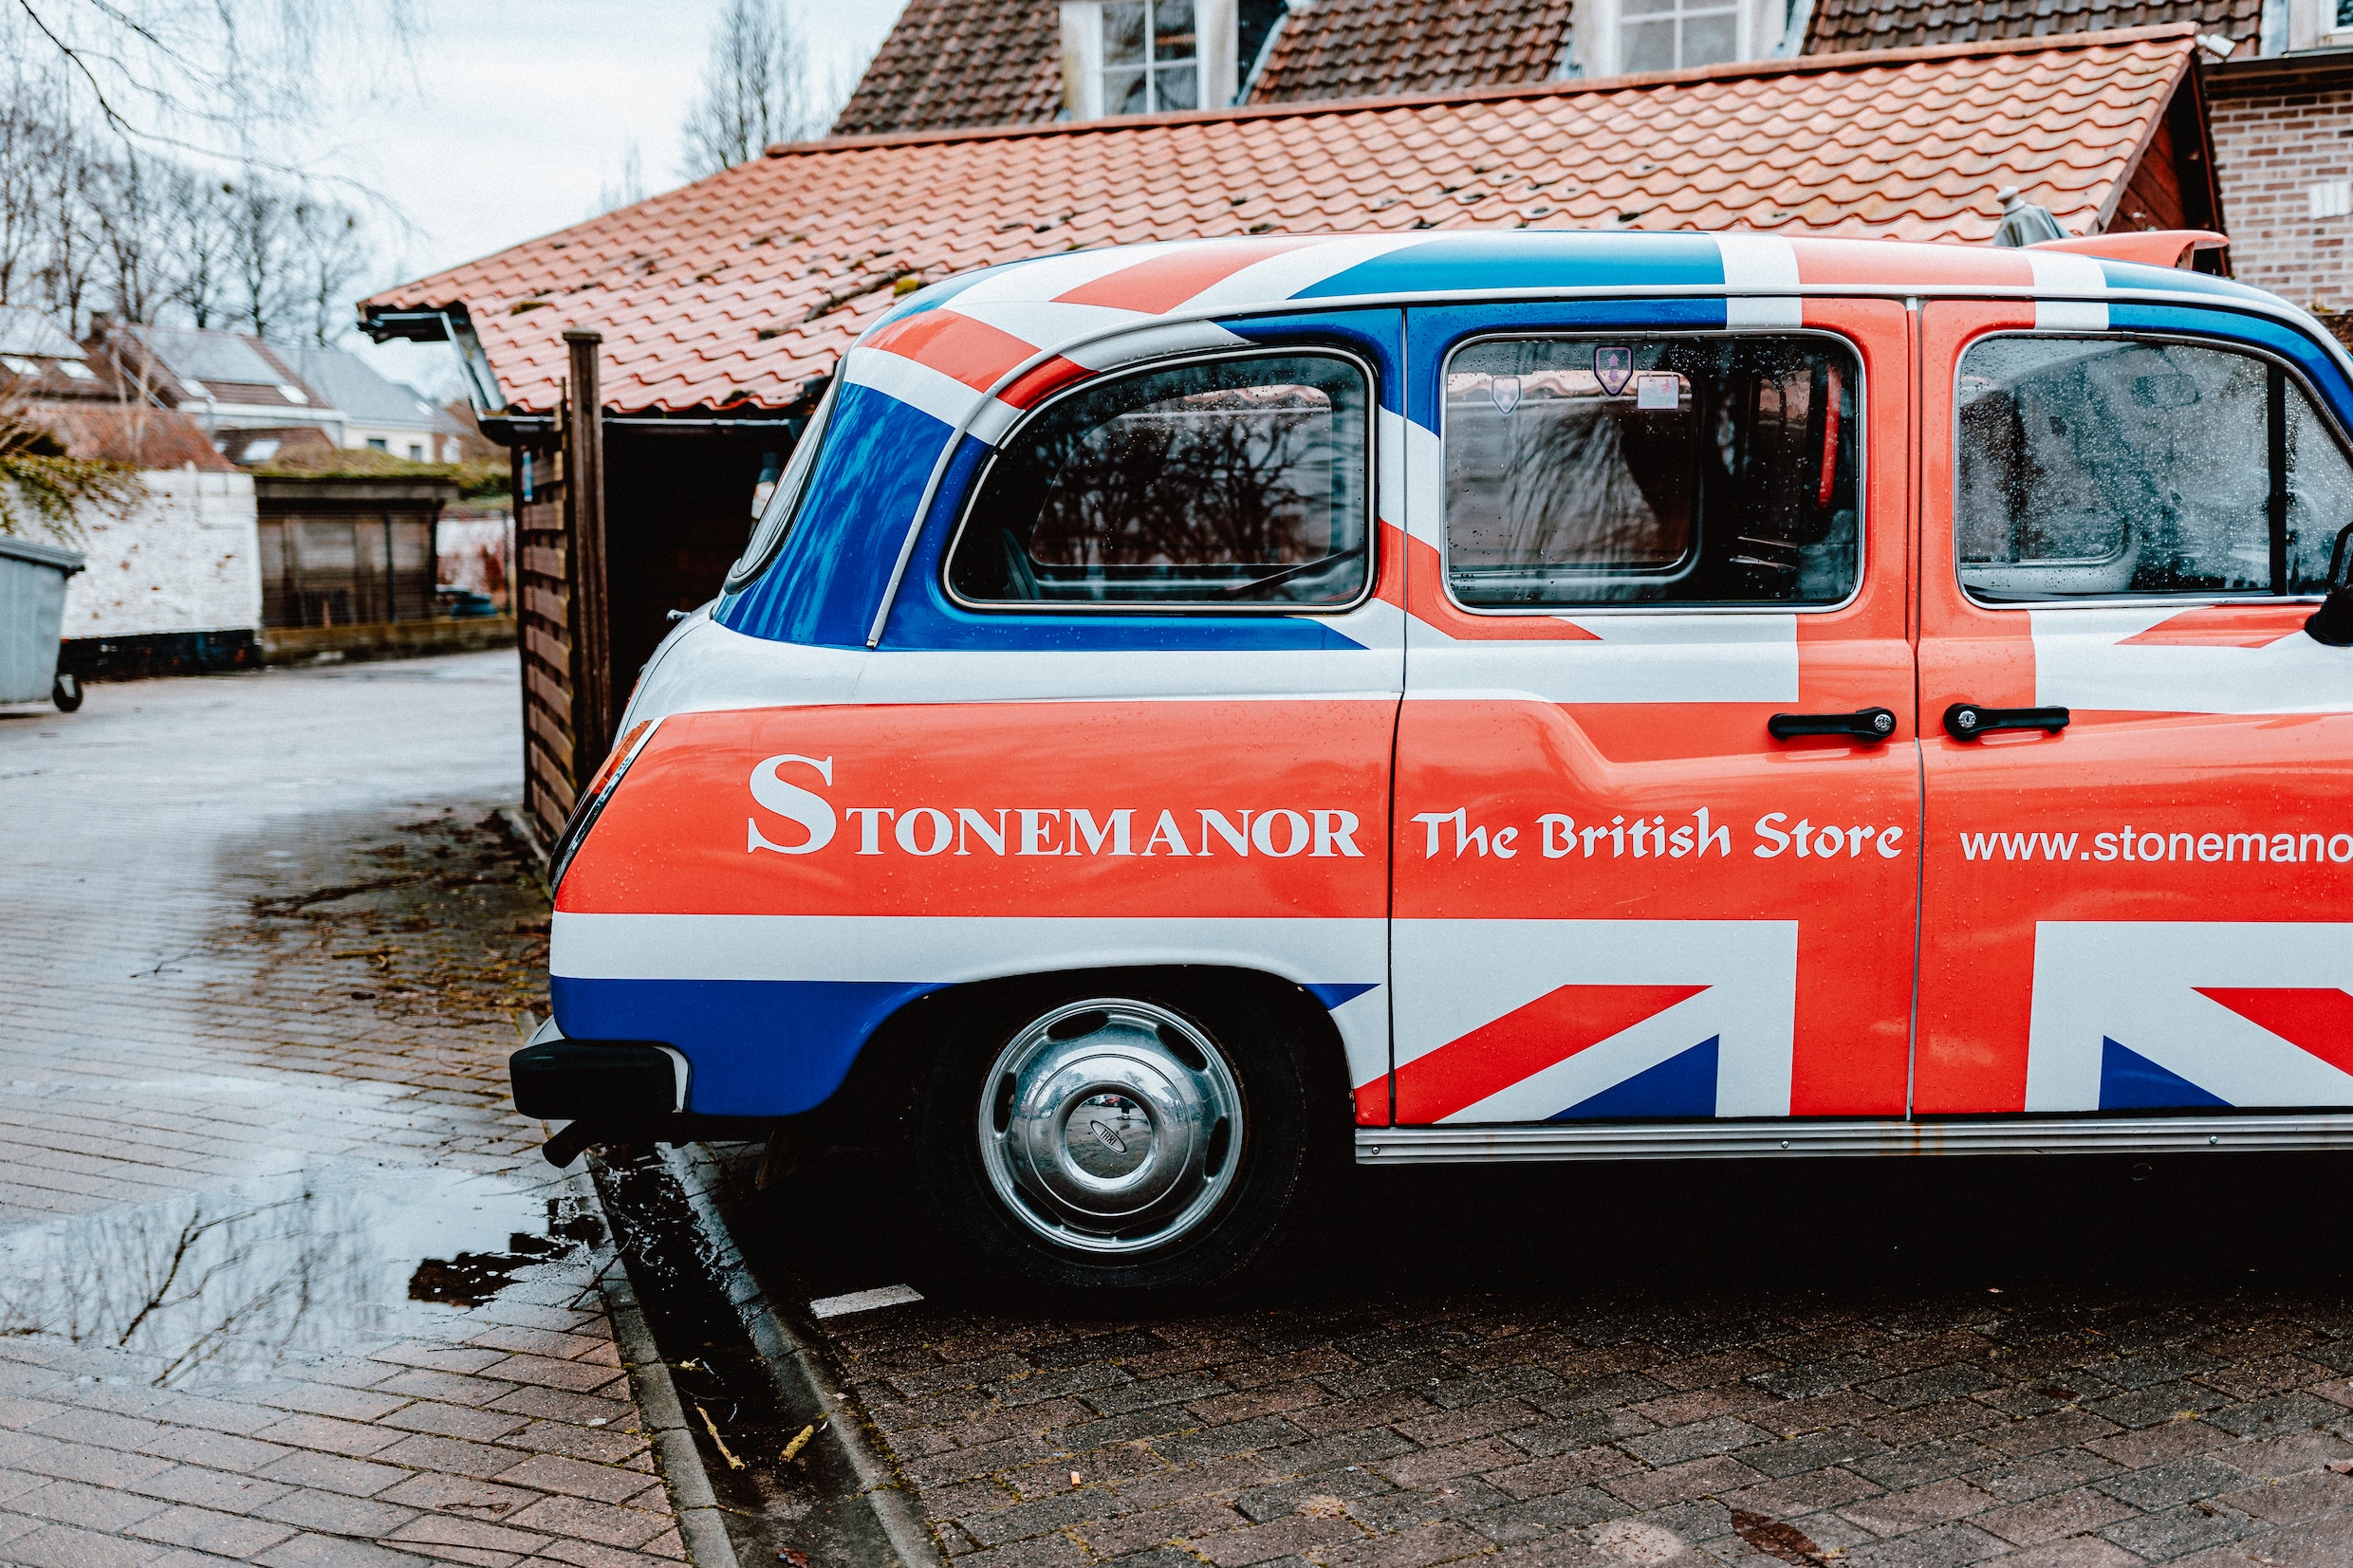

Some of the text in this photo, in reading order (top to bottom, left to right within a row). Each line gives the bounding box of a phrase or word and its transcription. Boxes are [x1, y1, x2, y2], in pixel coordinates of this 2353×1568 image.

[748, 754, 1364, 857] STONEMANOR
[1411, 806, 1903, 858] The British Store
[1960, 825, 2353, 862] www.stonemano
[1101, 1128, 1118, 1146] TAXI
